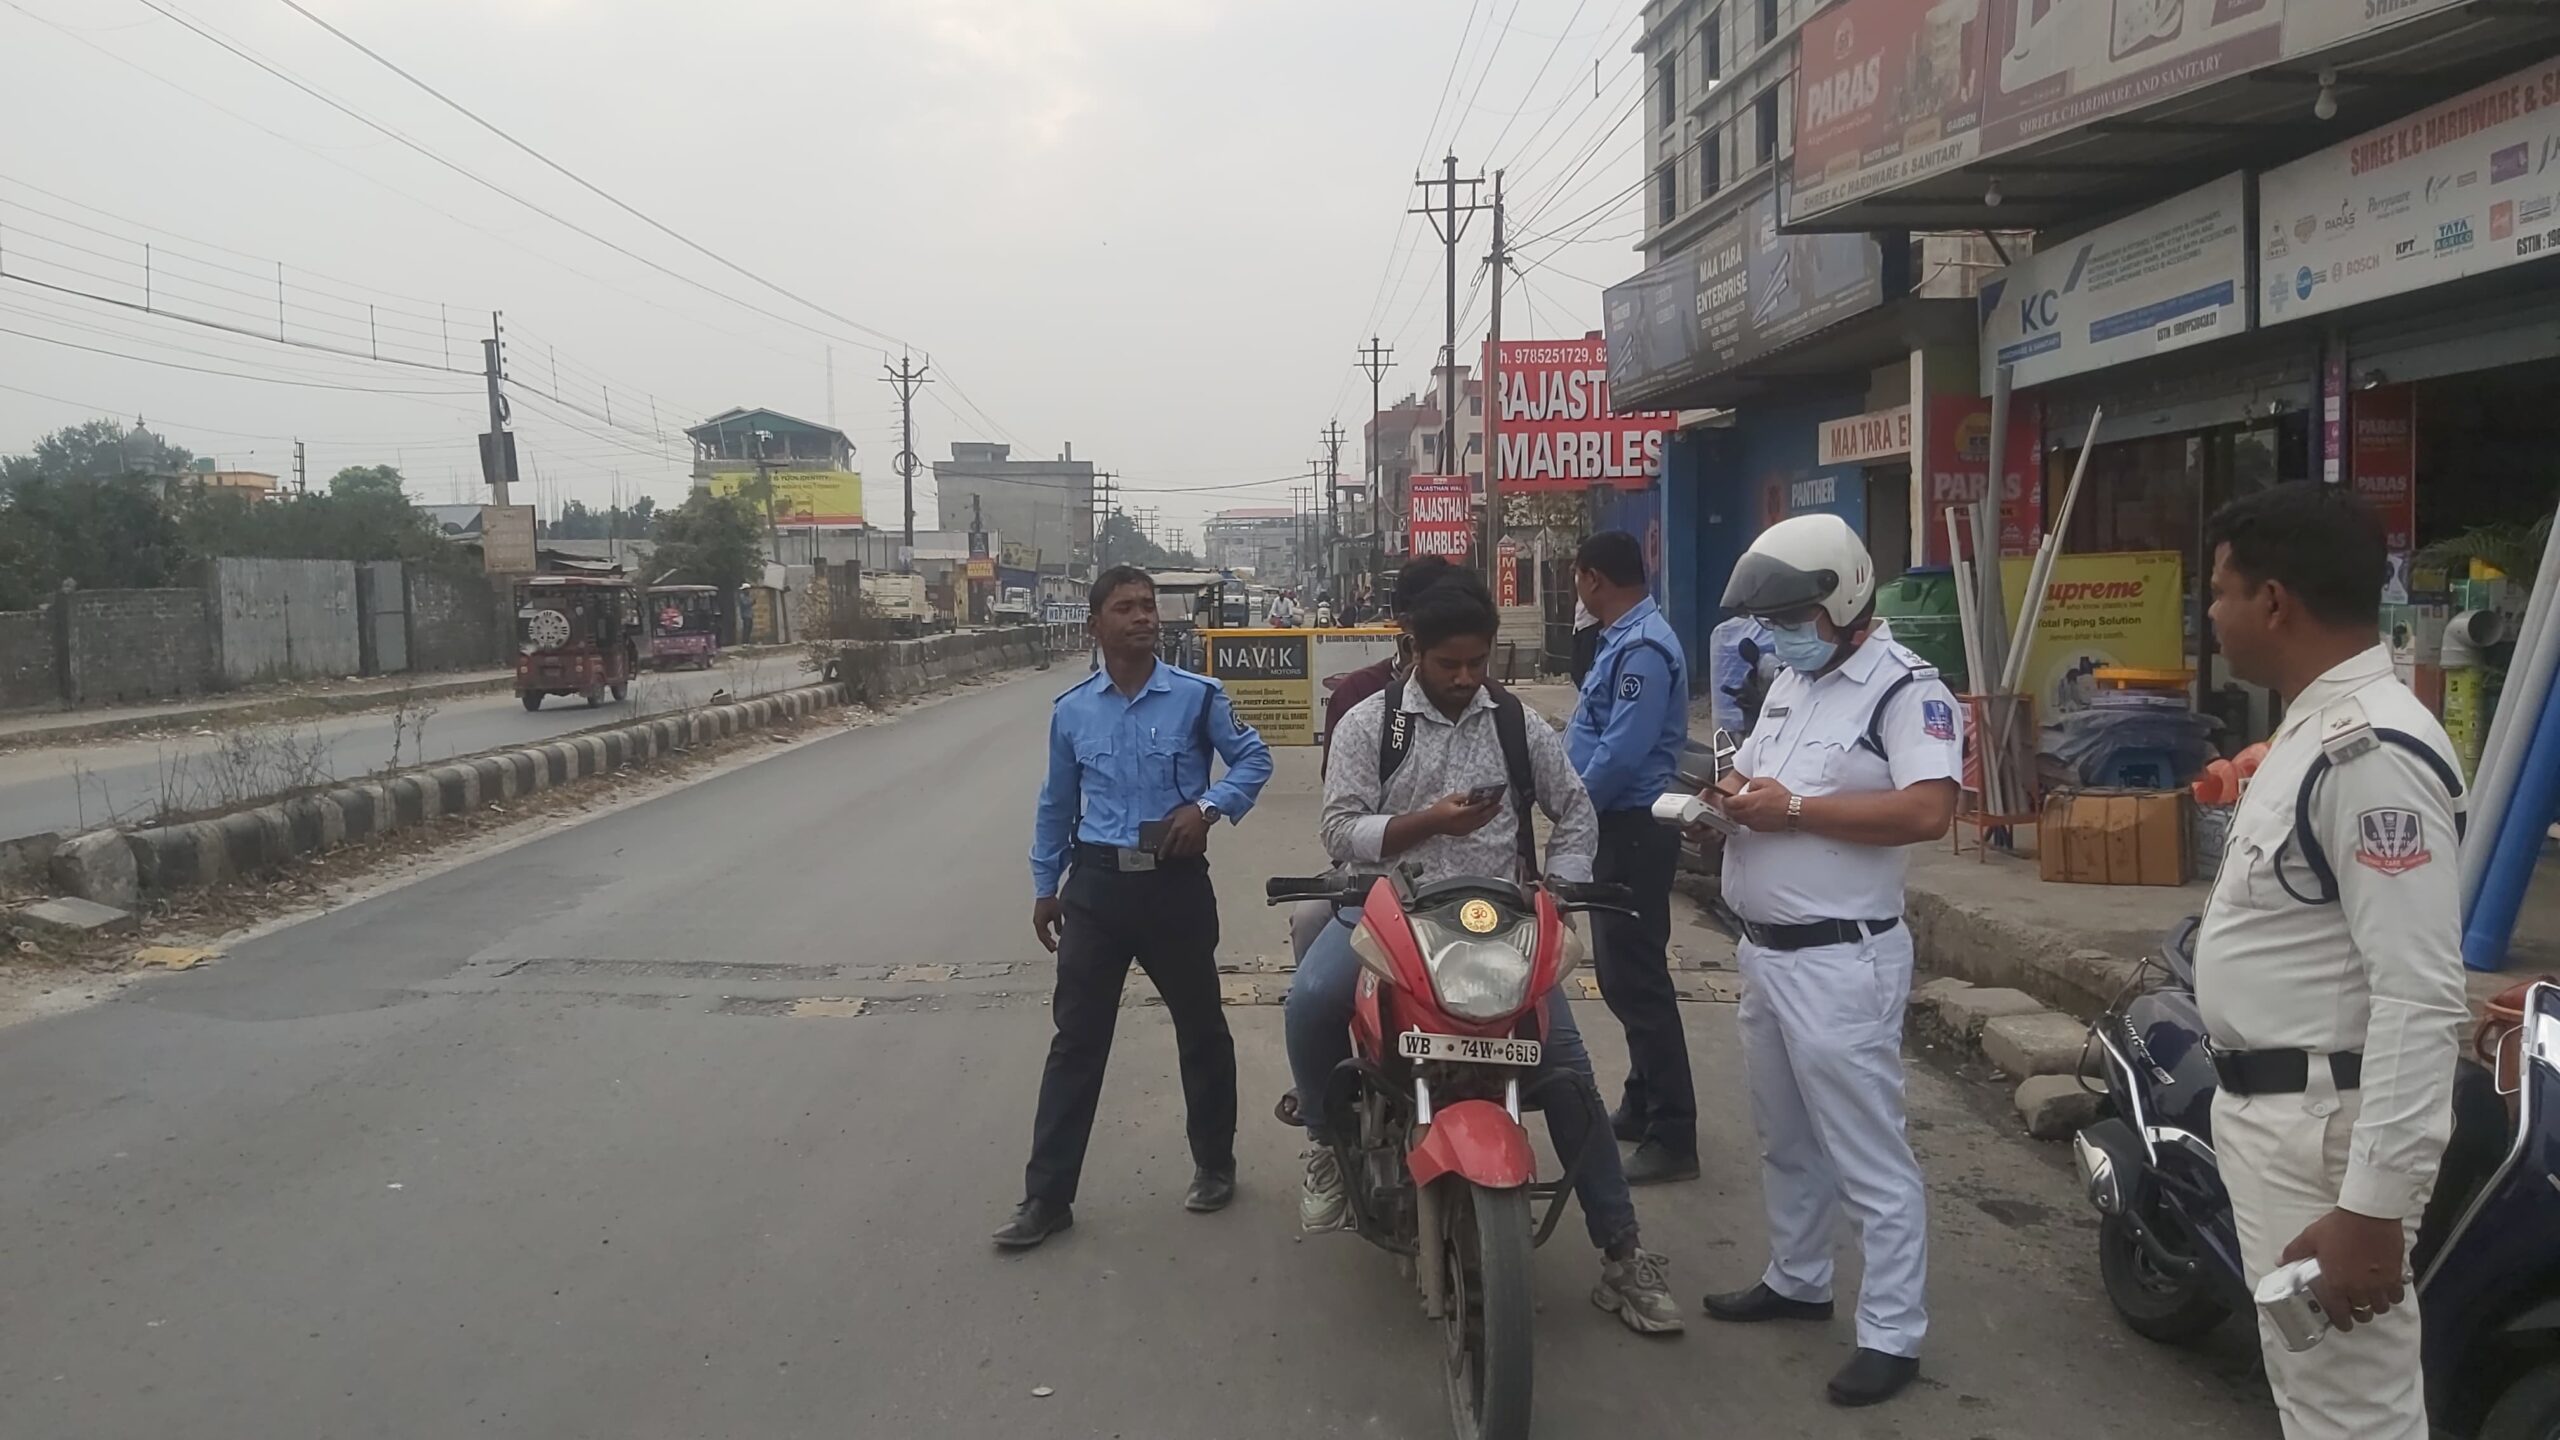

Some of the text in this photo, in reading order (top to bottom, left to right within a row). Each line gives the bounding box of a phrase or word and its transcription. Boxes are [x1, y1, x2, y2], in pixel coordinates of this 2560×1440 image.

[1806, 55, 1882, 132] PARAS
[2018, 113, 2050, 136] SHREE
[2068, 86, 2132, 120] HARDWARE
[2133, 75, 2159, 98] AND
[2161, 52, 2223, 84] SANITARY
[1946, 113, 1976, 132] GARDEN
[2350, 133, 2395, 177] SHREE
[2424, 85, 2520, 149] HARDWARE
[2523, 86, 2538, 114] &
[1803, 189, 1829, 210] SHREE
[1847, 164, 1899, 195] HARDWARE
[1901, 162, 1908, 176] &
[1911, 142, 1963, 173] SANITARY
[2434, 230, 2474, 250] AGRICO
[2439, 219, 2468, 237] TATA
[2396, 239, 2415, 255] KPT
[2517, 234, 2541, 256] GSTIN
[1700, 243, 1743, 284] MAA TARA
[2347, 255, 2380, 276] BOSCH
[1697, 271, 1748, 314] ENTERPRISE
[2021, 288, 2059, 335] KC
[1515, 347, 1592, 366] 9785251729,
[1831, 428, 1857, 457] MAA
[1860, 419, 1892, 451] TARA
[2357, 418, 2407, 434] PARAS
[1498, 430, 1663, 480] MARBLES
[1792, 477, 1835, 508] PANTHER
[1933, 472, 2022, 500] PARS
[2357, 476, 2407, 491] PARAS
[1415, 531, 1468, 555] MARBLES
[2047, 581, 2143, 608] upreme
[2063, 617, 2096, 628] Piping
[2099, 615, 2142, 626] Solution
[1218, 647, 1293, 668] NAVIK
[1391, 708, 1406, 750] safari
[1405, 1036, 1431, 1055] WB
[1461, 1040, 1494, 1058] 74W
